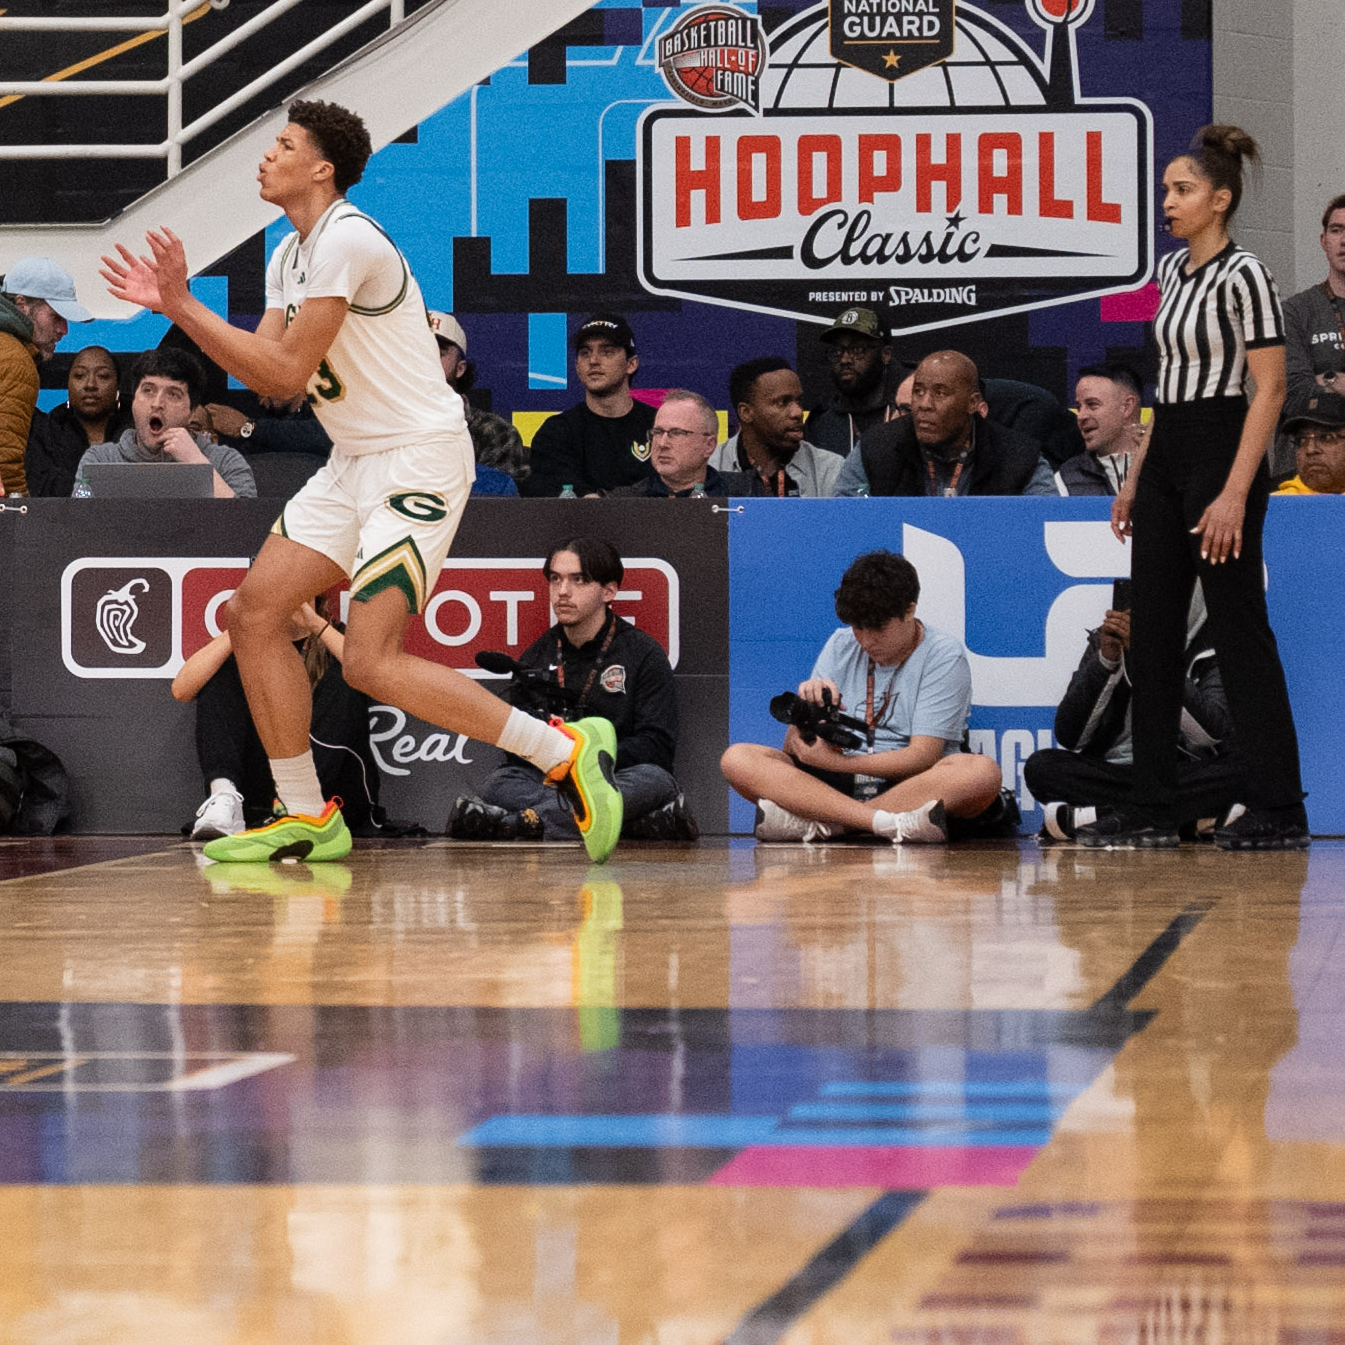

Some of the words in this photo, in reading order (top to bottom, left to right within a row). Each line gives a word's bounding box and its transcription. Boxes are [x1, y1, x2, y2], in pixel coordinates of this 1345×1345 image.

[665, 18, 755, 57] BASKETBALL
[841, 15, 942, 40] GUARD
[700, 48, 731, 68] HALL
[737, 50, 757, 75] OF
[717, 69, 756, 107] FAME
[674, 130, 1123, 229] HOOPHALL
[800, 207, 983, 271] Classic
[808, 290, 866, 303] PRESENTED
[867, 290, 887, 303] BY
[888, 284, 978, 307] SPALDING
[390, 492, 448, 523] G
